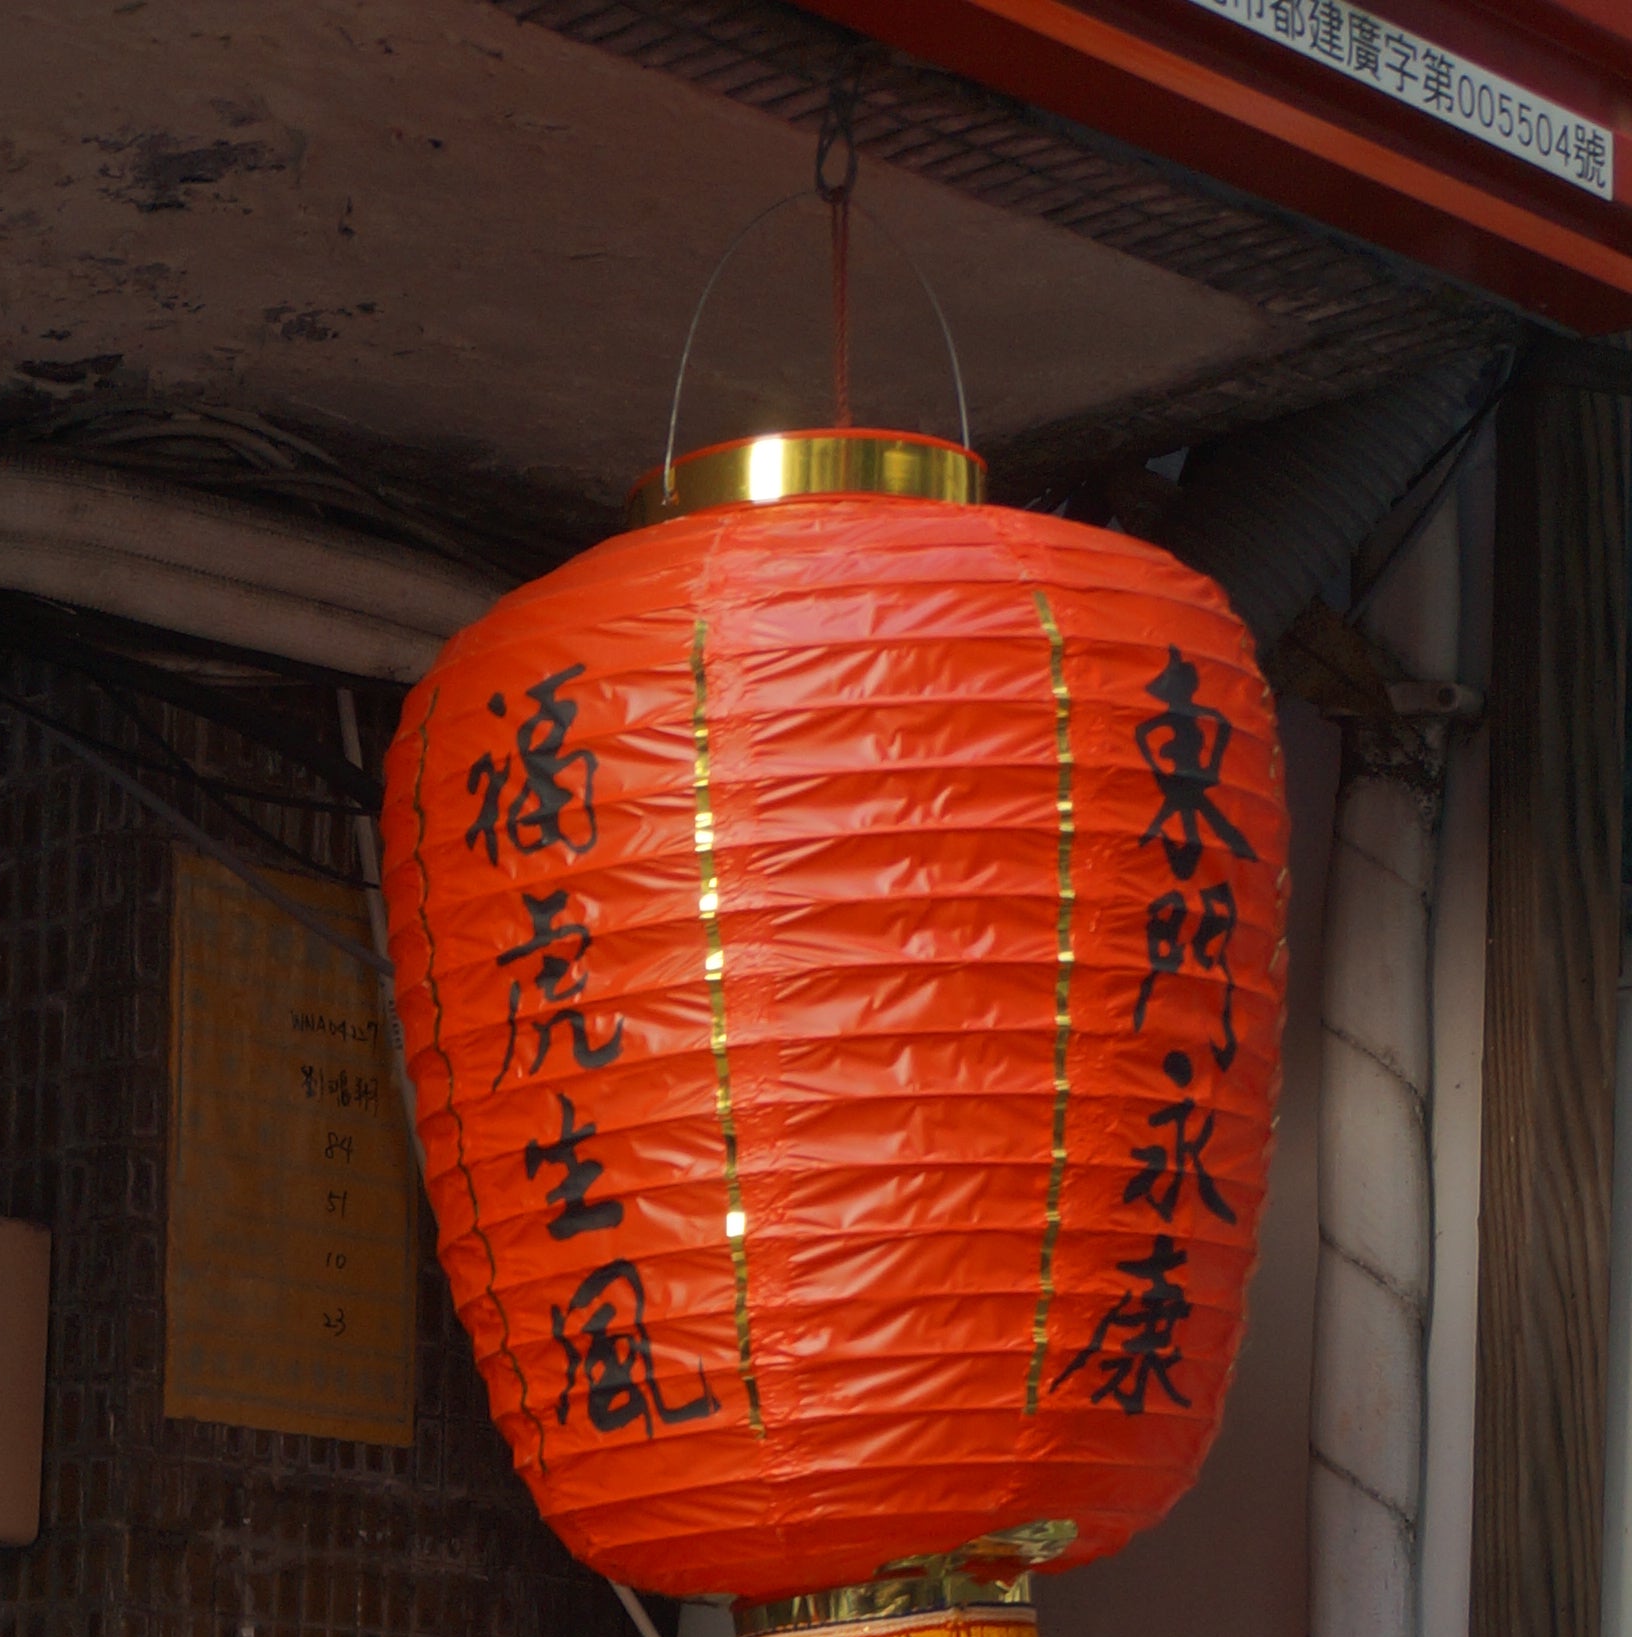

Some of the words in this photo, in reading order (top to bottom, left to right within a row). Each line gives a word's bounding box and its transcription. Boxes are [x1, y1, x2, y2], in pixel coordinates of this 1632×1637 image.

[1213, 0, 1607, 189] 都建廣字第005504號
[1050, 643, 1258, 1416] 東門永康
